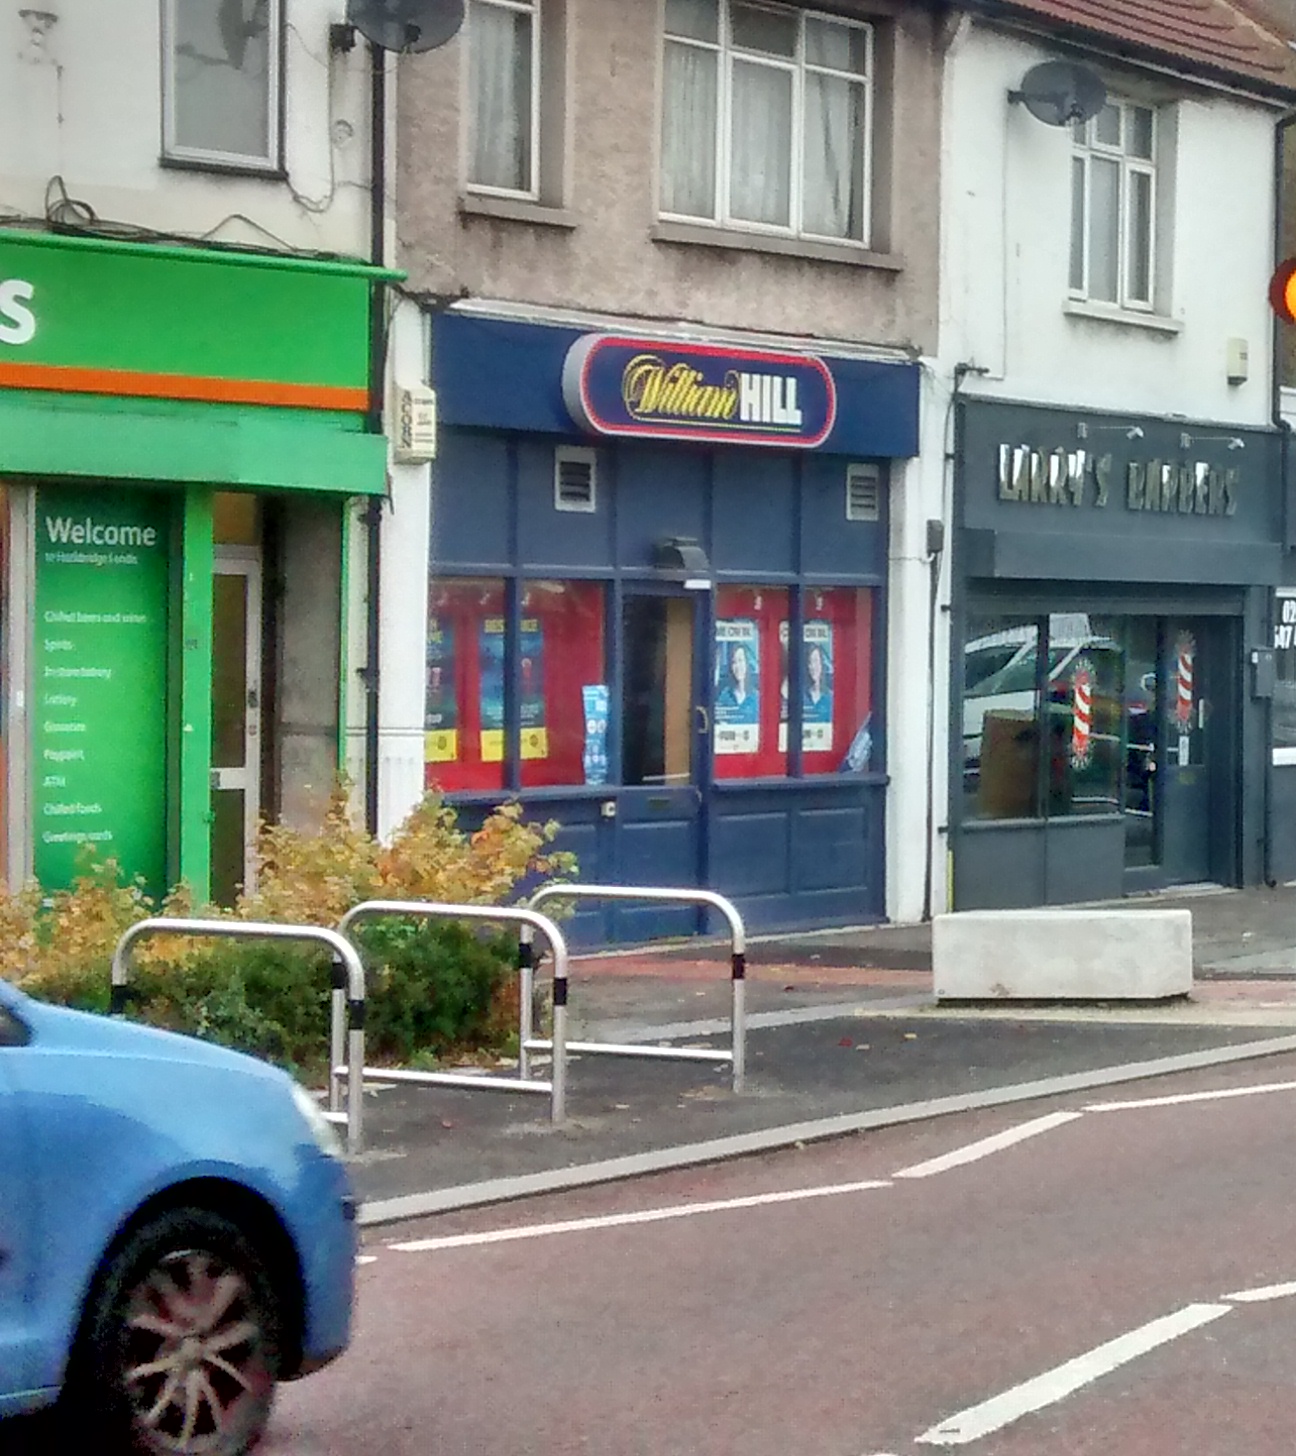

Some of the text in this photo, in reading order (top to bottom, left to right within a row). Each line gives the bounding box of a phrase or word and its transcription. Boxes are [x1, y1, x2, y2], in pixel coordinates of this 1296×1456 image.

[622, 353, 802, 425] William HILL
[999, 443, 1240, 516] LARRY'S BARBERS
[45, 516, 156, 546] Welcome
